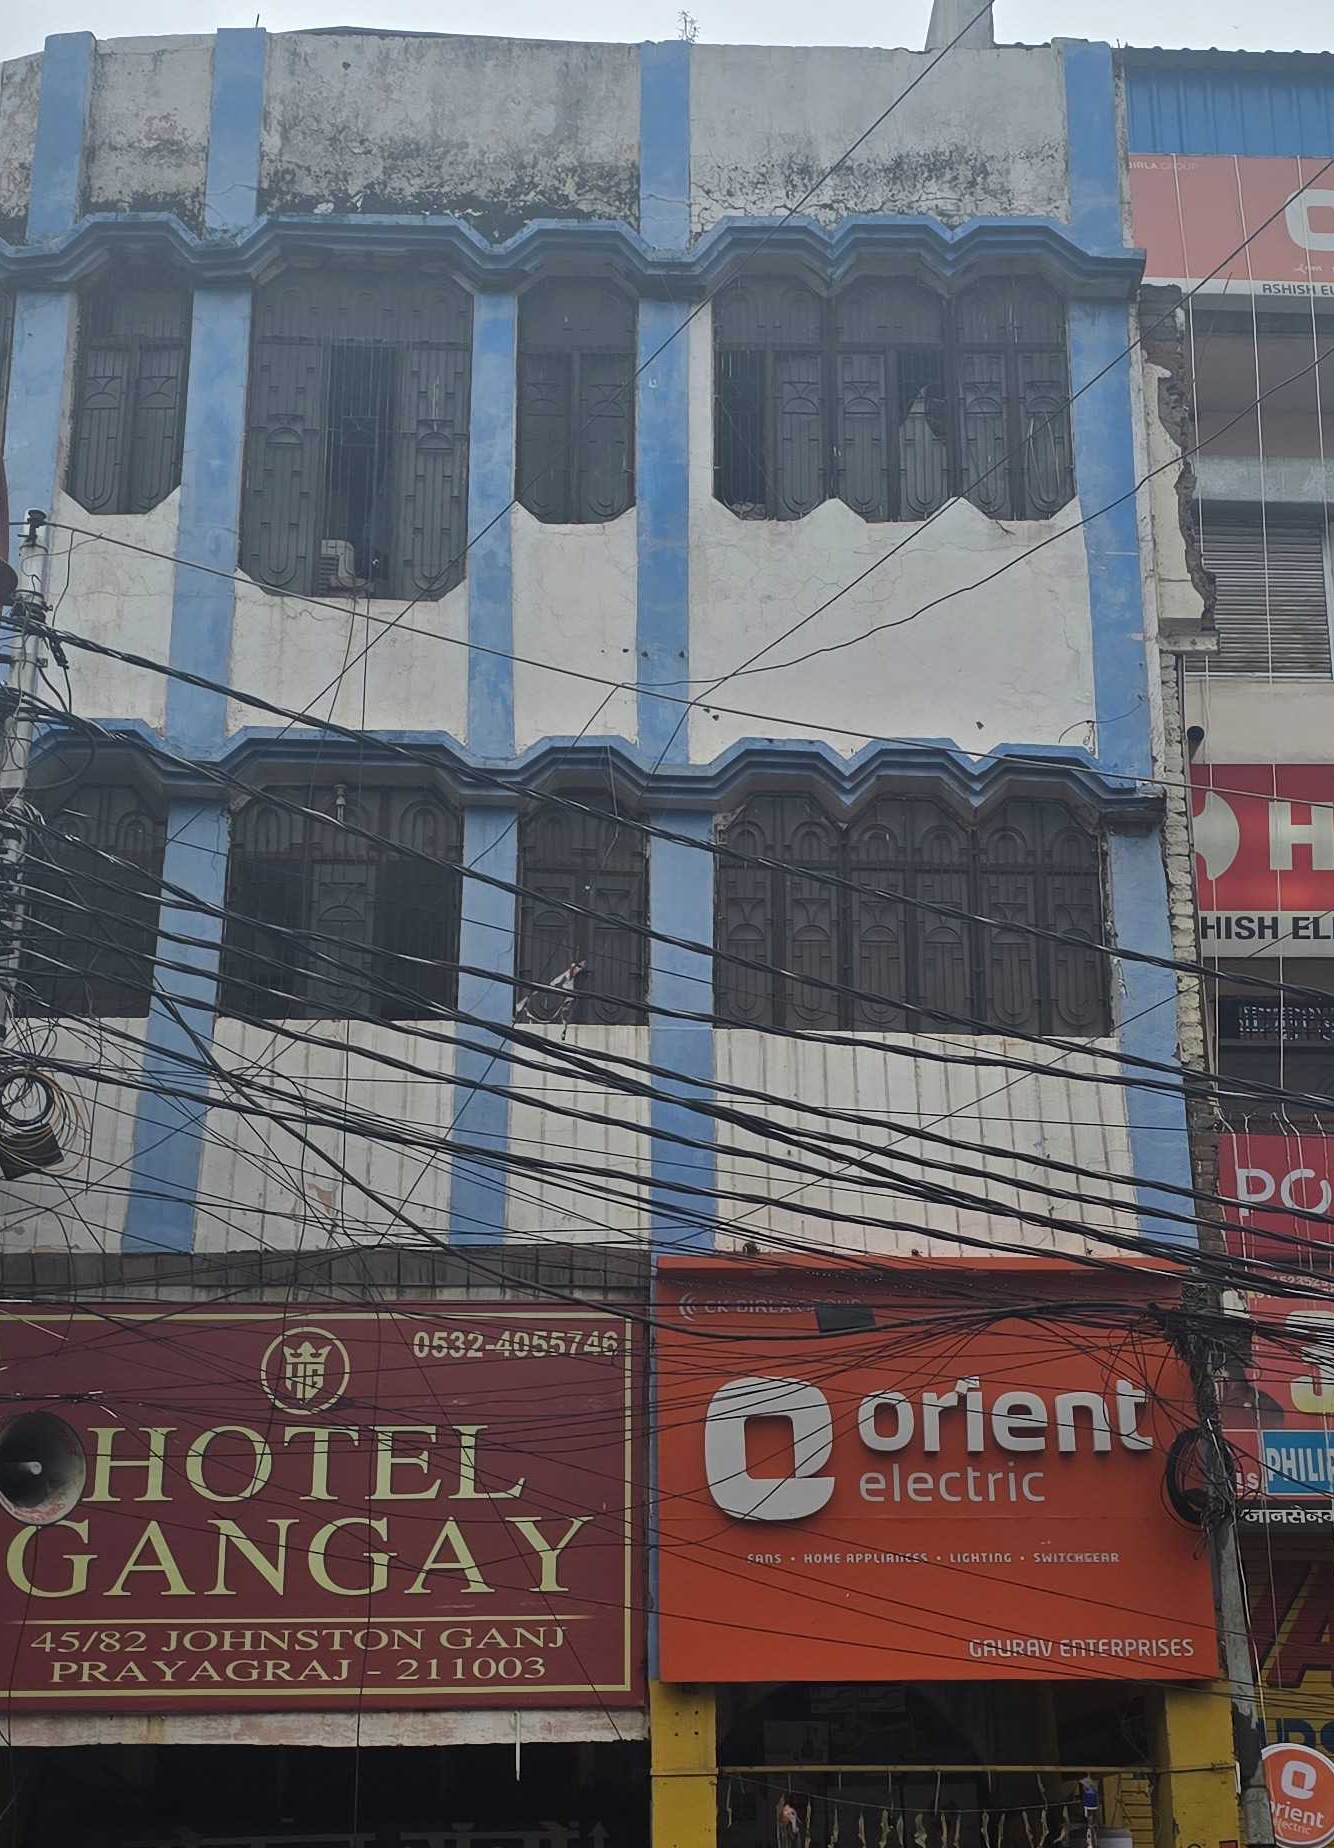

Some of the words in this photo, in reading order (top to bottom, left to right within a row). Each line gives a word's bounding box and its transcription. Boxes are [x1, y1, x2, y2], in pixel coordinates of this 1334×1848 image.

[1262, 282, 1311, 297] ASHISH
[412, 1330, 619, 1358] 0532-4055746
[857, 1374, 1154, 1453] orient
[83, 1425, 526, 1503] HOTEL
[858, 1462, 1046, 1503] electric
[4, 1516, 597, 1597] GANGAY
[803, 1552, 841, 1564] HOME
[950, 1552, 1012, 1564] LIGHTING
[1033, 1551, 1121, 1564] SWITCHGEAR
[30, 1631, 147, 1653] 45/82
[161, 1627, 426, 1653] JOHNSTON
[439, 1626, 567, 1651] GANJ
[969, 1638, 1053, 1659] GAURAV
[1060, 1638, 1195, 1658] ENTERPRISES
[50, 1658, 353, 1684] PRAYAGRAJ
[397, 1656, 546, 1681] 211003
